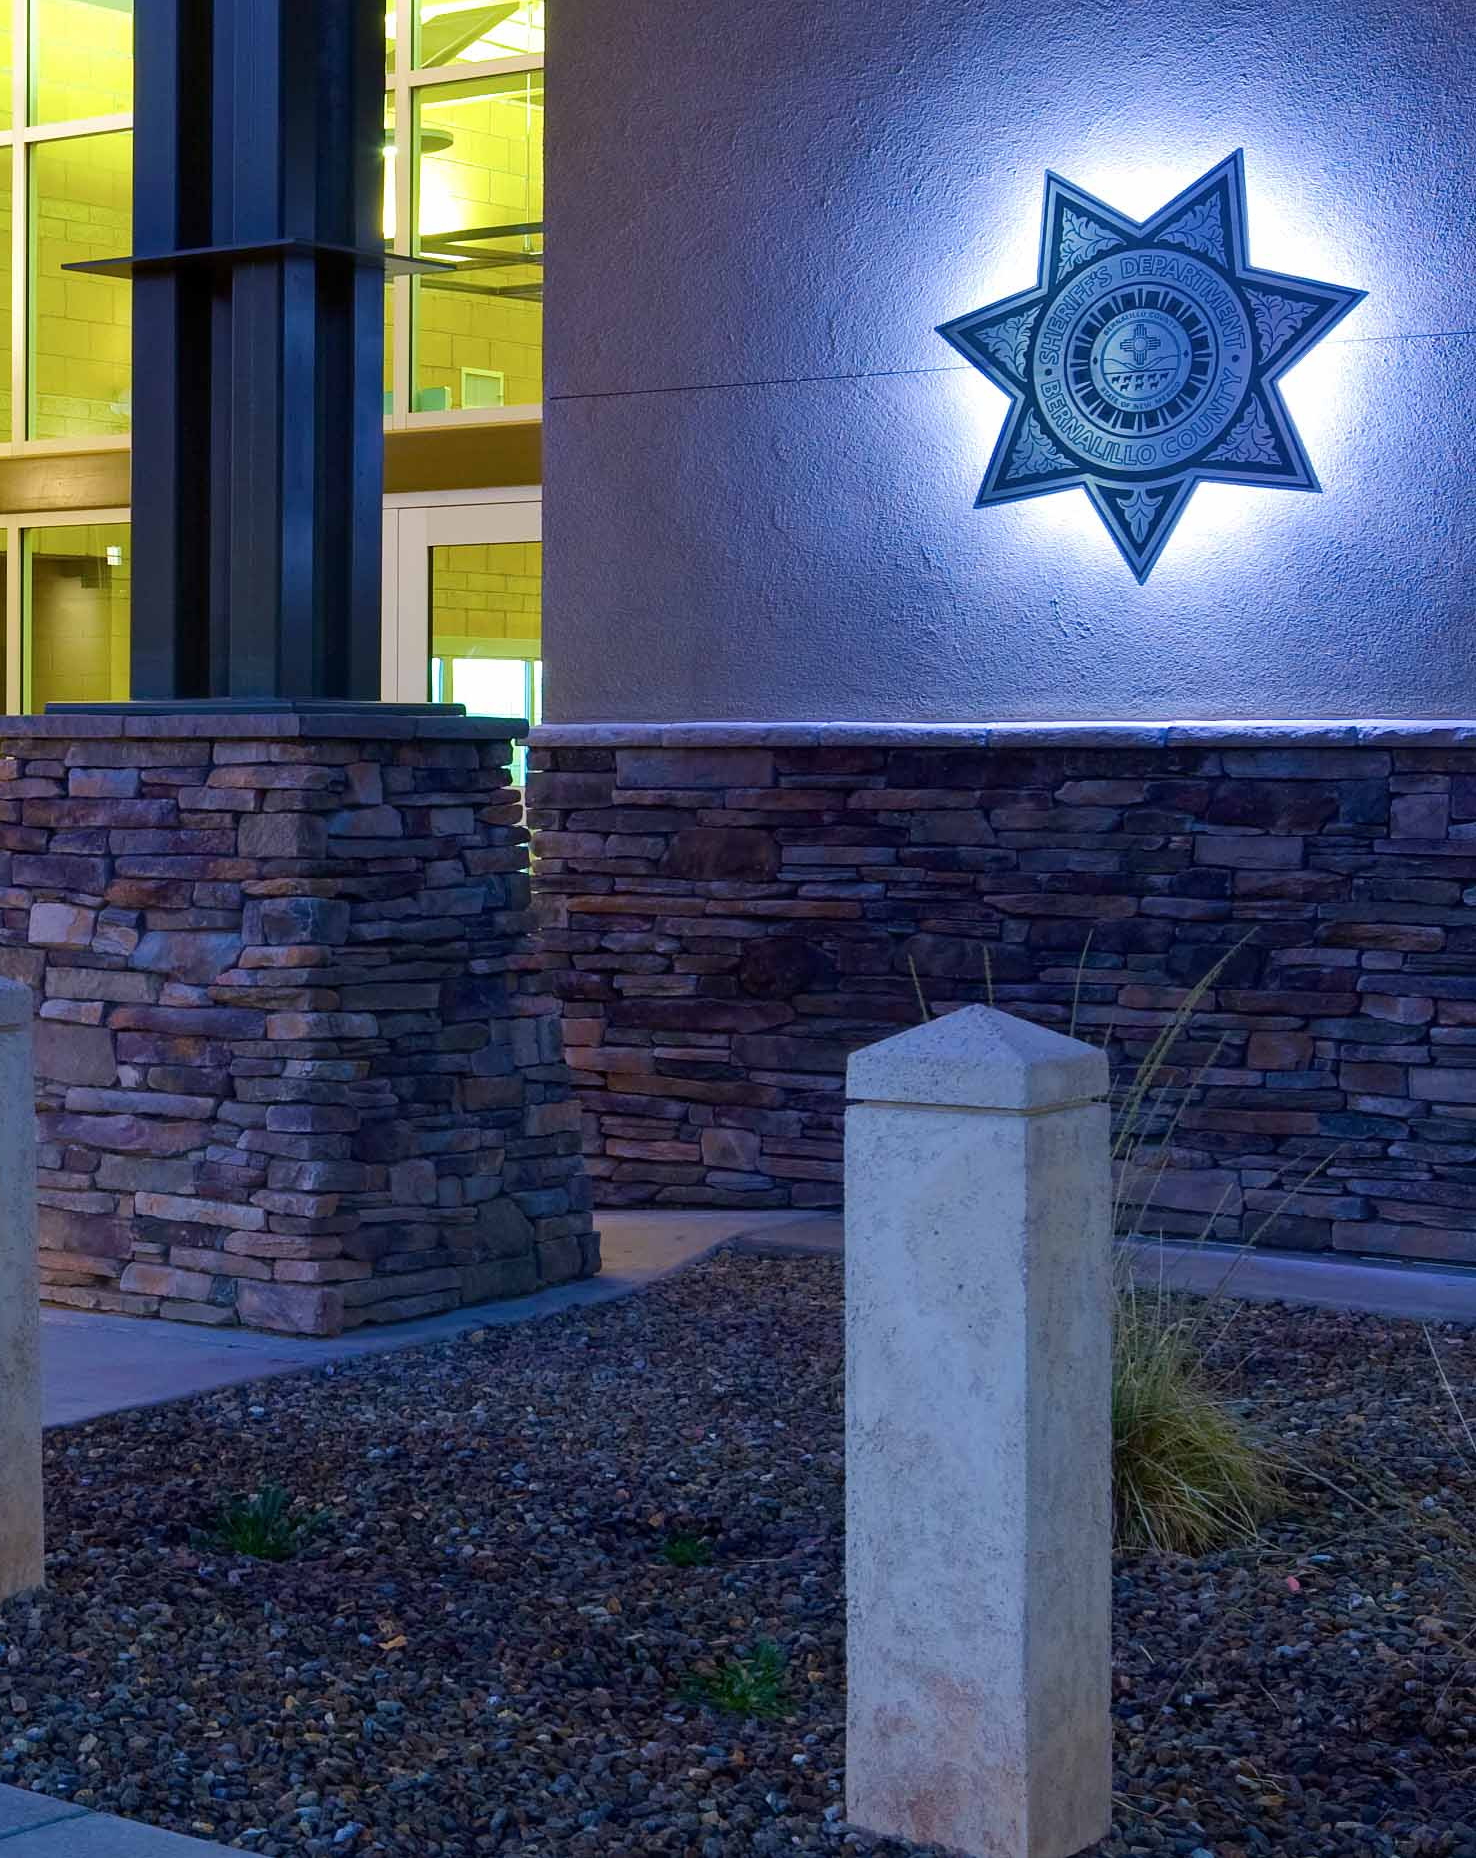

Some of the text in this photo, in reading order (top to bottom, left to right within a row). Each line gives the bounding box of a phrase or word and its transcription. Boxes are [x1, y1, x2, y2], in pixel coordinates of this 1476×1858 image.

[1039, 254, 1246, 366] SHERIFF'S DEPARTMENT
[1040, 367, 1243, 467] BERNALILLO COUNTY
